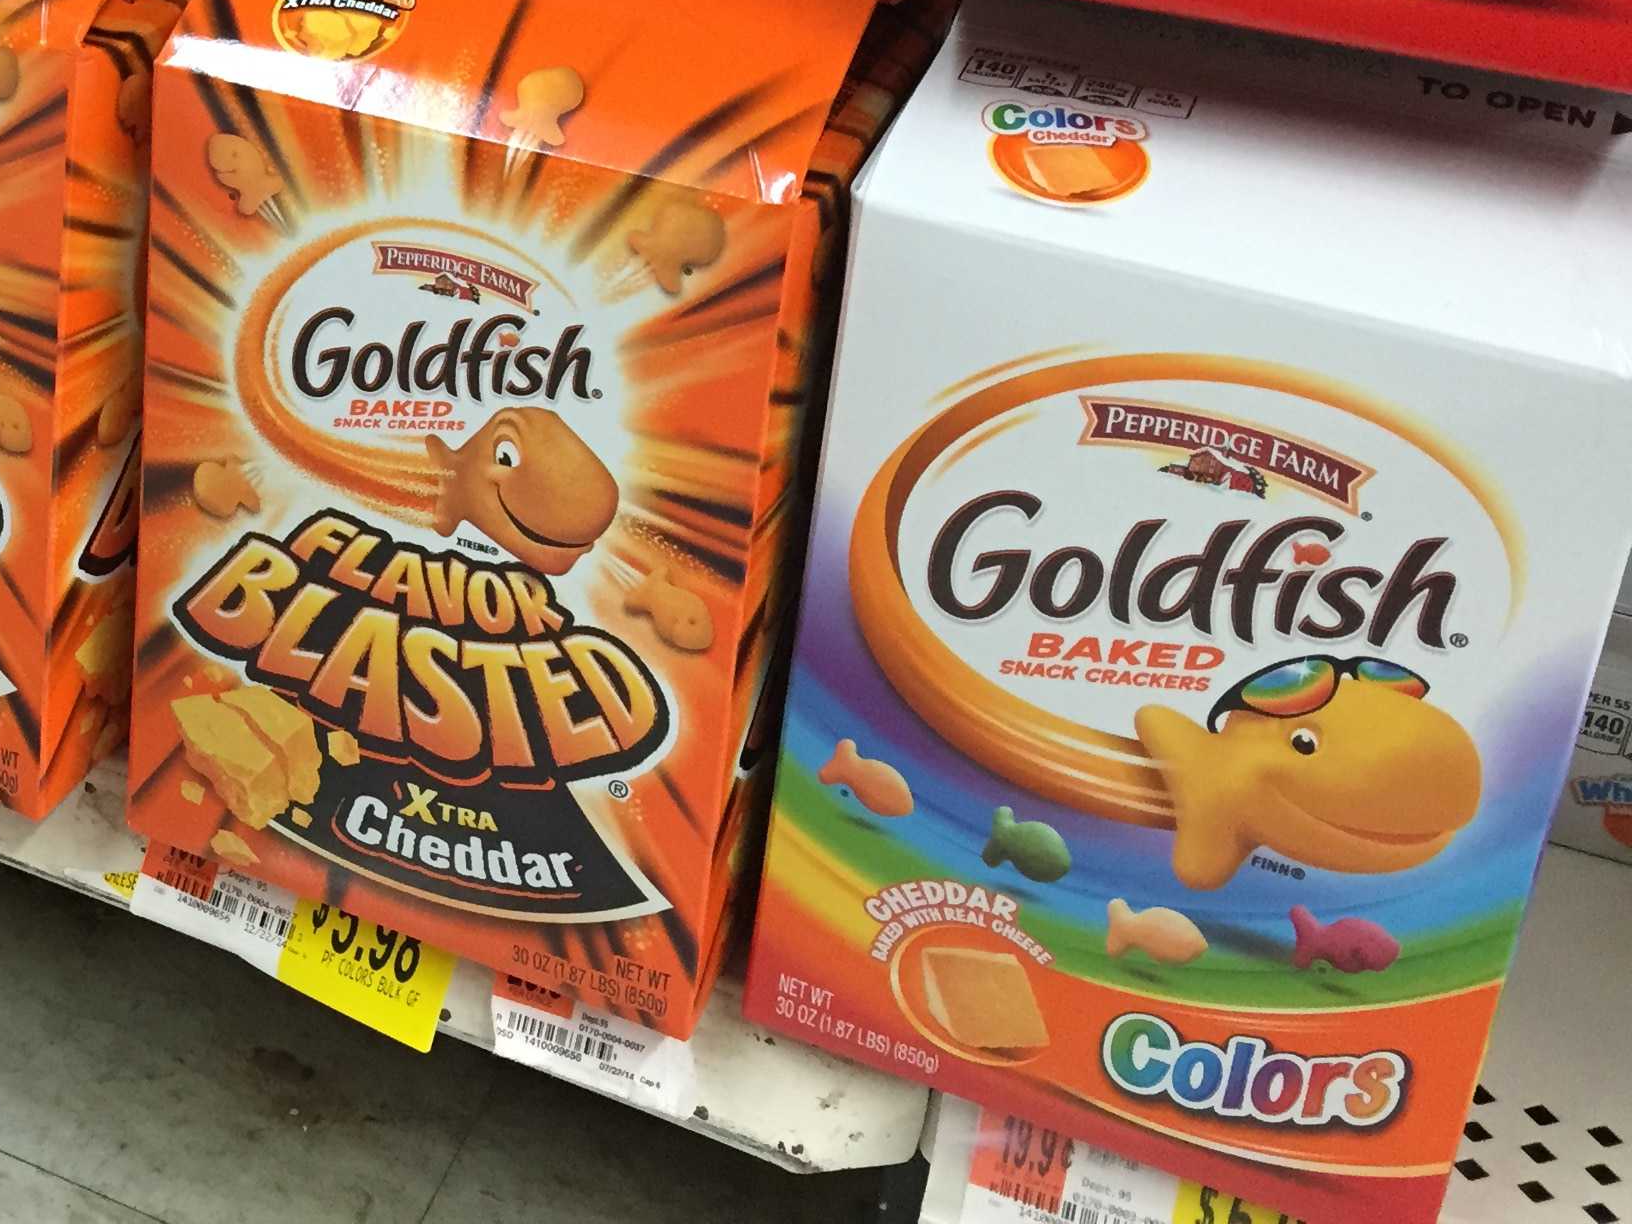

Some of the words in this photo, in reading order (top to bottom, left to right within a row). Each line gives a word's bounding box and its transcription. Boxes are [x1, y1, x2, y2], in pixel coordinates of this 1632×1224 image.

[972, 60, 1017, 75] 140
[992, 104, 1138, 136] Colors
[1417, 76, 1470, 102] TO
[1485, 89, 1598, 130] OPEN
[1033, 130, 1111, 144] Cheddar
[386, 247, 476, 278] PEPPERIDGE
[479, 264, 524, 299] FARM
[333, 417, 382, 430] SNACK
[387, 418, 466, 432] CRACKERS
[349, 399, 453, 418] BAKED
[1105, 406, 1265, 458] PEPPERIDGE
[1268, 437, 1342, 491] FARM
[287, 514, 566, 637] FLAVOR
[184, 537, 660, 772] BLASTED
[1028, 633, 1225, 671] BAKED
[999, 659, 1079, 683] SNACK
[1084, 665, 1212, 693] CRACKERS
[1583, 711, 1625, 736] 140
[1, 747, 20, 769] WT
[399, 782, 499, 833] XTRA
[344, 794, 574, 890] Cheddar
[864, 880, 1017, 922] CHEDDAR
[871, 922, 903, 962] BAKED
[900, 907, 943, 929] WITH
[943, 906, 987, 928] REAL
[992, 919, 1053, 966] CHEESE
[321, 950, 336, 966] PF
[338, 956, 375, 988] COLORS
[376, 975, 403, 1002] BULK
[512, 944, 530, 966] 30
[533, 951, 552, 974] OZ
[590, 972, 622, 999] LBS)
[624, 983, 668, 1018] (850g)
[616, 958, 644, 982] NET
[648, 969, 672, 993] WT
[778, 973, 806, 999] NET
[808, 983, 835, 1010] WT
[775, 996, 796, 1020] 30
[797, 1002, 817, 1026] OZ
[820, 1009, 856, 1040] (1.87
[857, 1024, 891, 1056] LBS)
[894, 1041, 940, 1075] (850g)
[1105, 1014, 1404, 1126] Colors
